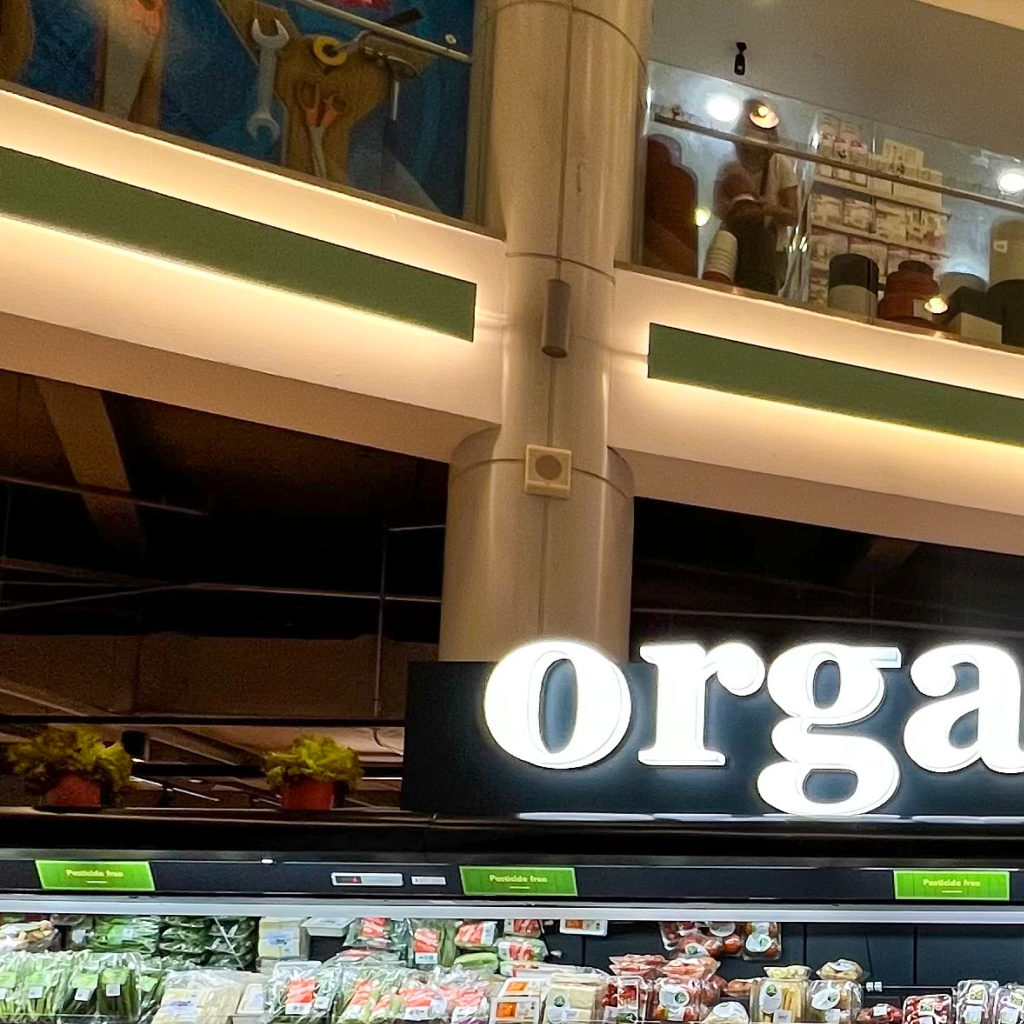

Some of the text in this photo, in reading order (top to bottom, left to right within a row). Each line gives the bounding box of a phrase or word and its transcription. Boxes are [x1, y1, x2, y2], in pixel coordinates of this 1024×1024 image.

[489, 874, 548, 883] Pesticide free
[922, 878, 981, 887] Pesticide free
